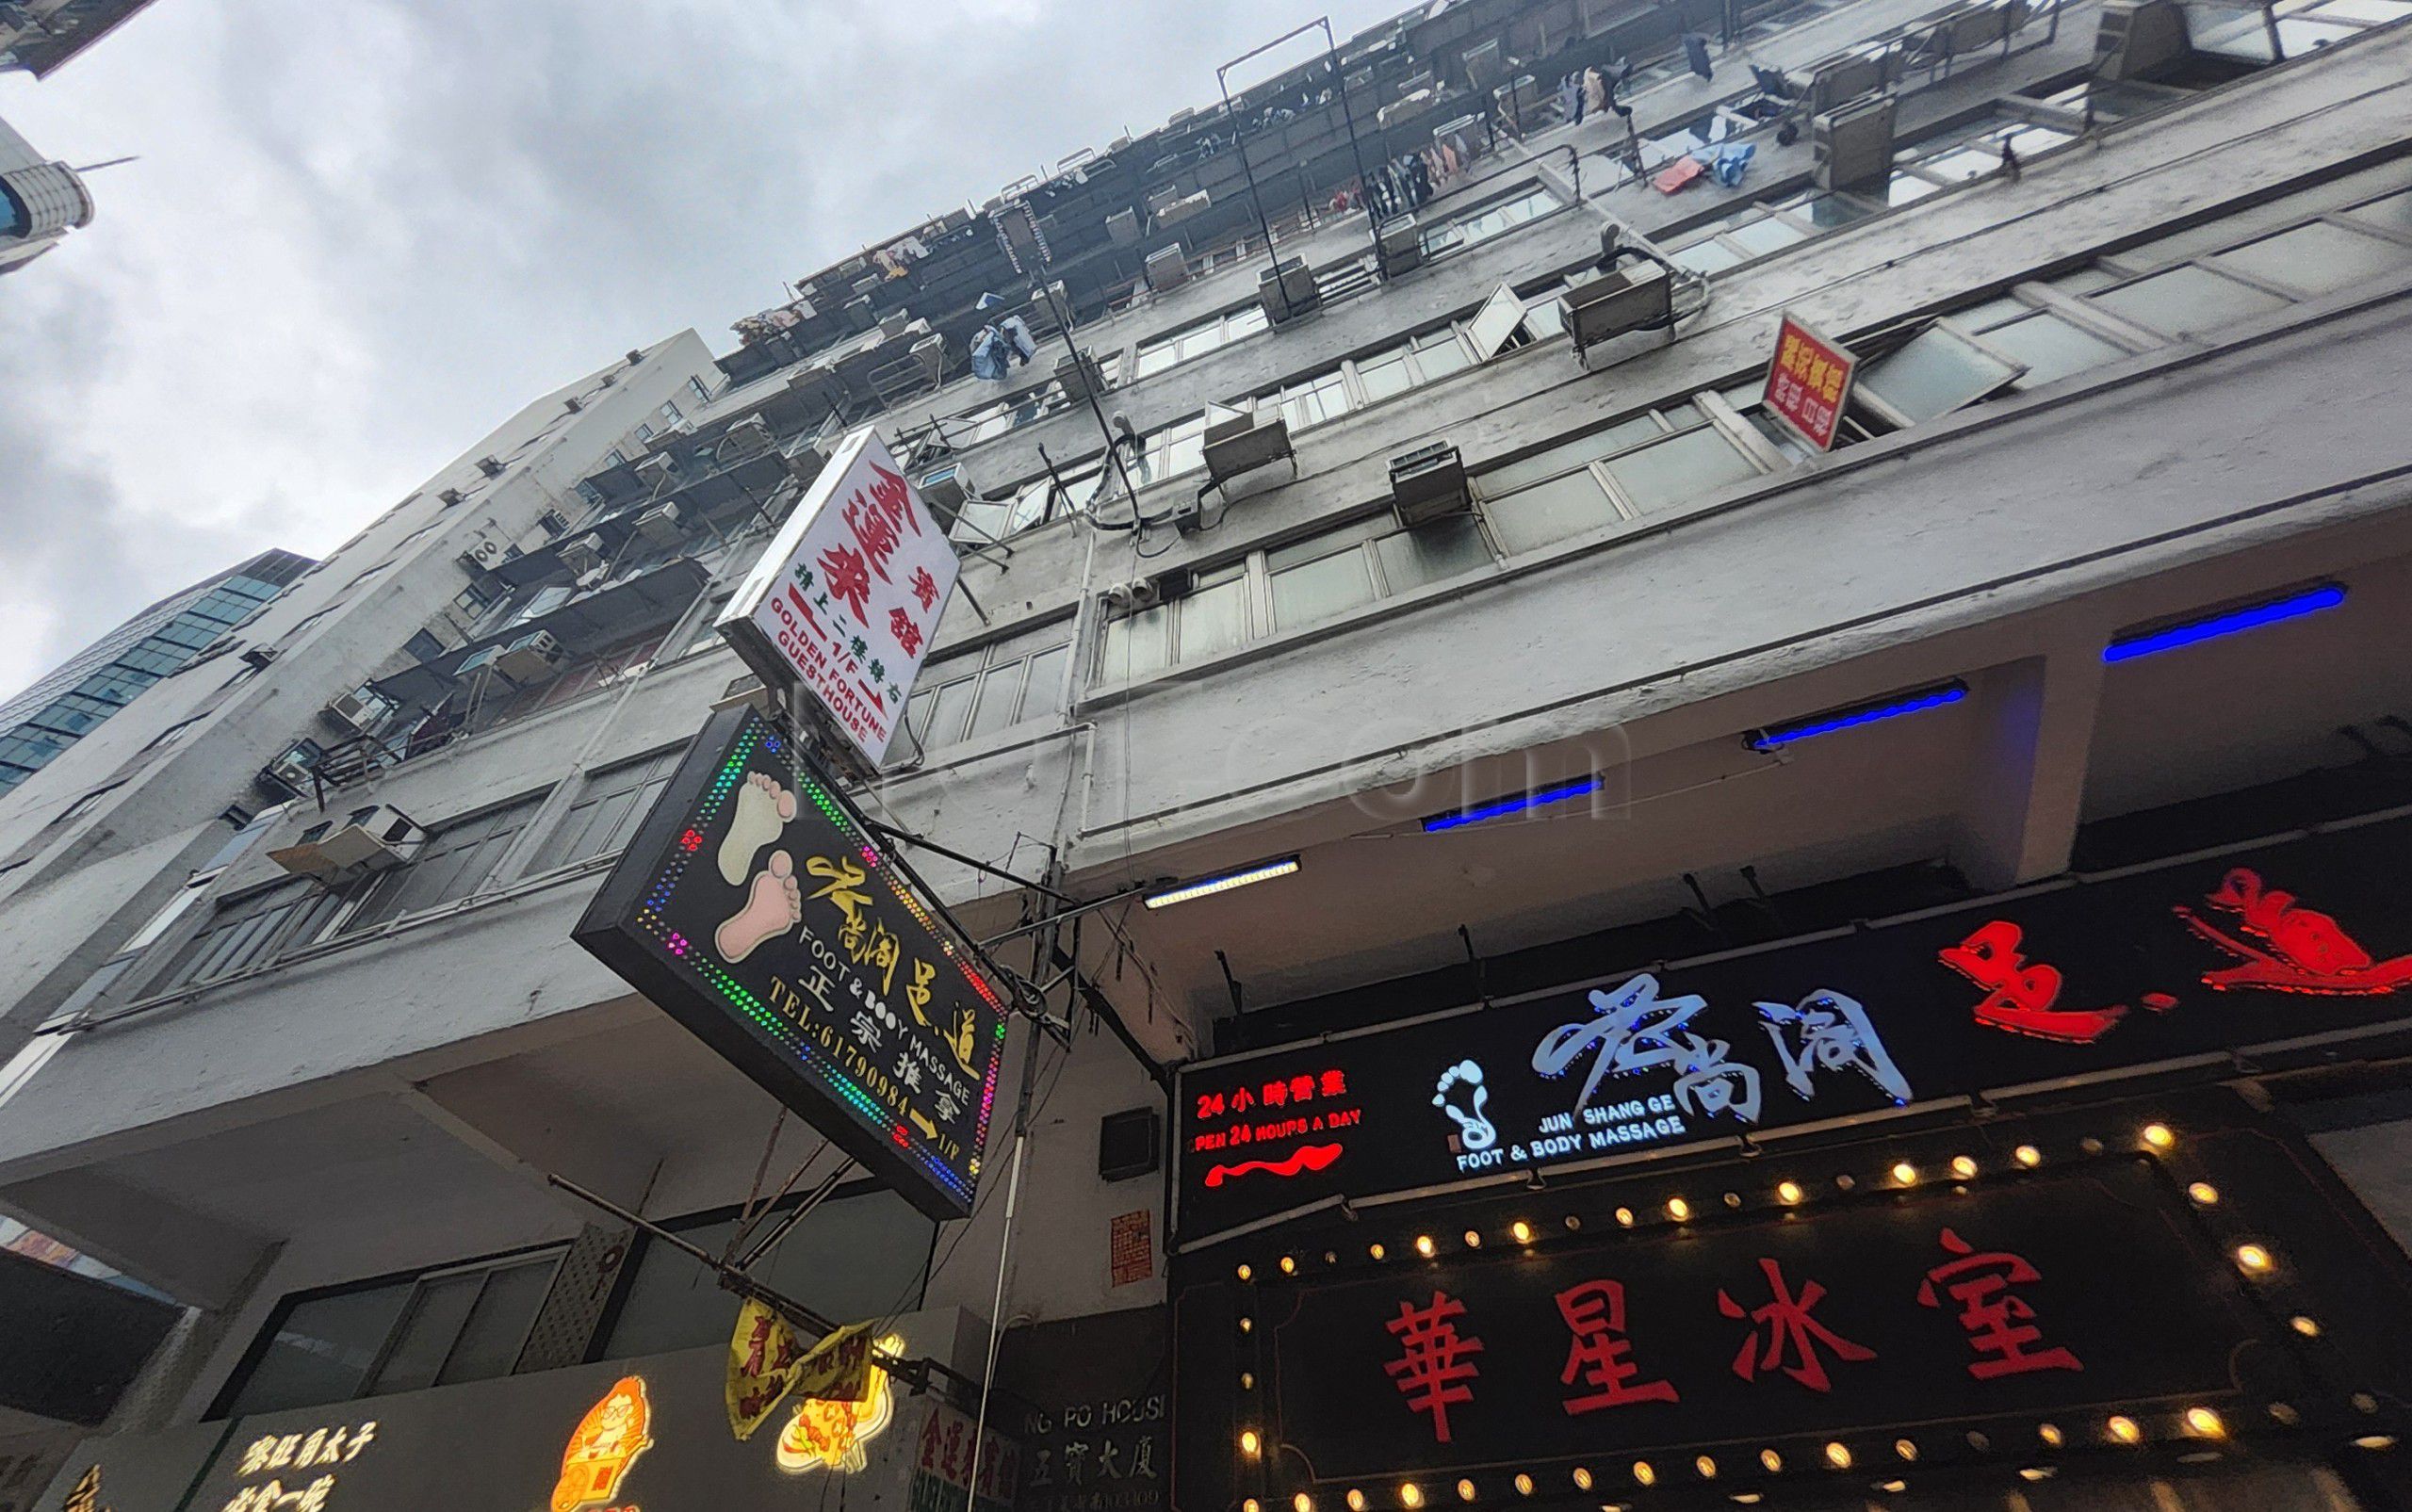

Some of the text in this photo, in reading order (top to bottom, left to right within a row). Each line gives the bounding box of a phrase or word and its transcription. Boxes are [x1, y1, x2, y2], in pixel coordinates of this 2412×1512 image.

[771, 596, 888, 744] GOLDEN FORTUNE
[776, 628, 868, 742] GUESTHOUSE
[832, 641, 859, 676] 1/F
[798, 926, 851, 983] FOOT
[849, 977, 863, 1000] &
[909, 1033, 970, 1106] MASSAGE
[798, 965, 961, 1126] 正宗推拿
[1230, 1124, 1251, 1146] 24
[1312, 1116, 1323, 1130] A
[1328, 1109, 1361, 1129] DAY
[1457, 1114, 1687, 1173] FOOT & BODY MASSAGE
[1539, 1094, 1675, 1133] JUN SHANG GE
[1384, 1227, 2083, 1441] 華星冰室
[1064, 1404, 1093, 1427] PO
